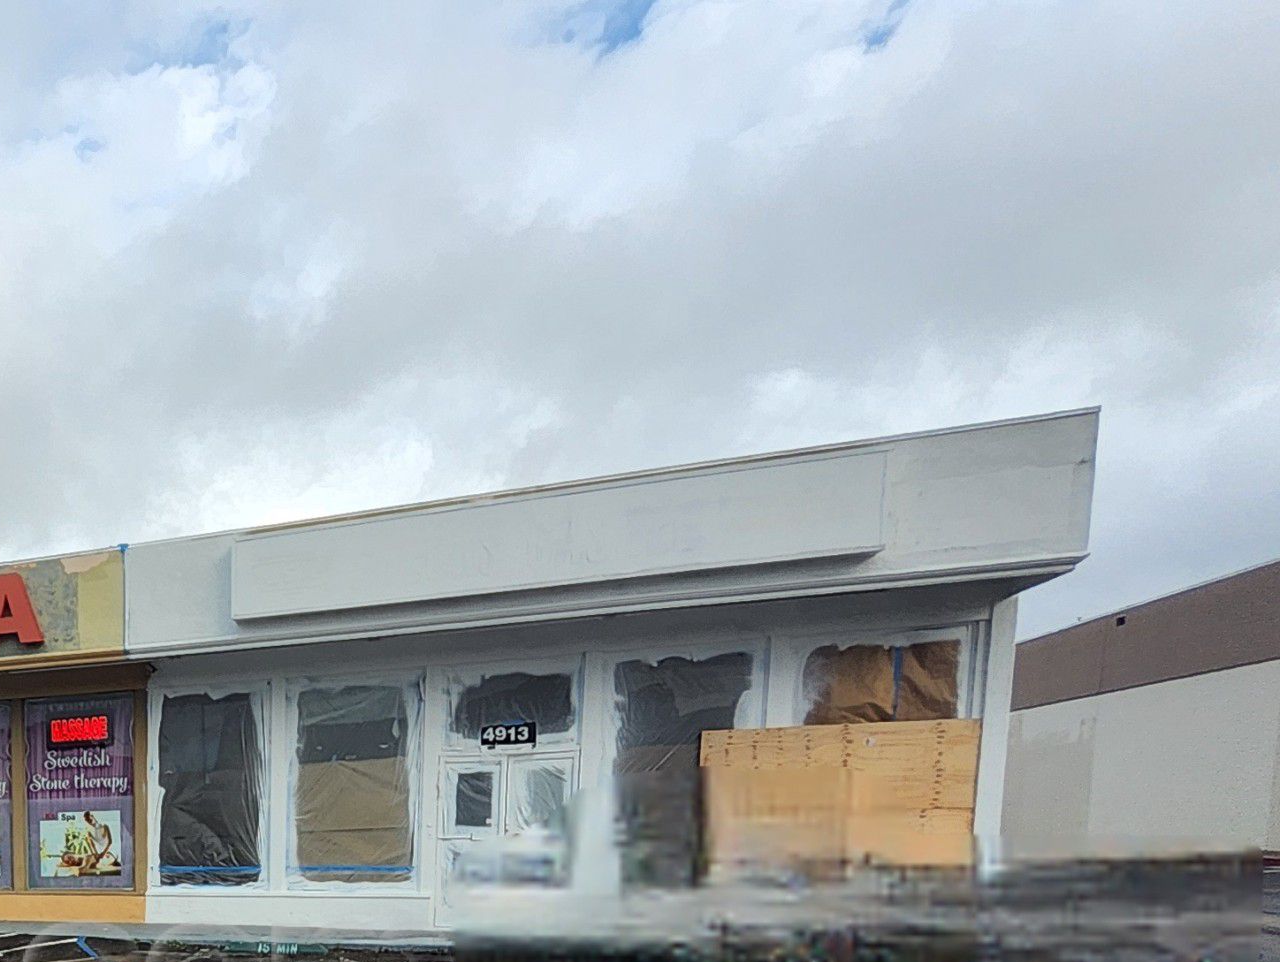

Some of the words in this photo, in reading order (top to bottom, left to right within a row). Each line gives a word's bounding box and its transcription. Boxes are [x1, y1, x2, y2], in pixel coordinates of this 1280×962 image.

[50, 715, 108, 742] MASSAGE
[483, 726, 529, 741] 4913
[44, 747, 112, 770] Swedish
[29, 773, 70, 792] Stone
[74, 772, 128, 793] therapy
[257, 942, 271, 954] 15
[276, 943, 298, 955] MIN
